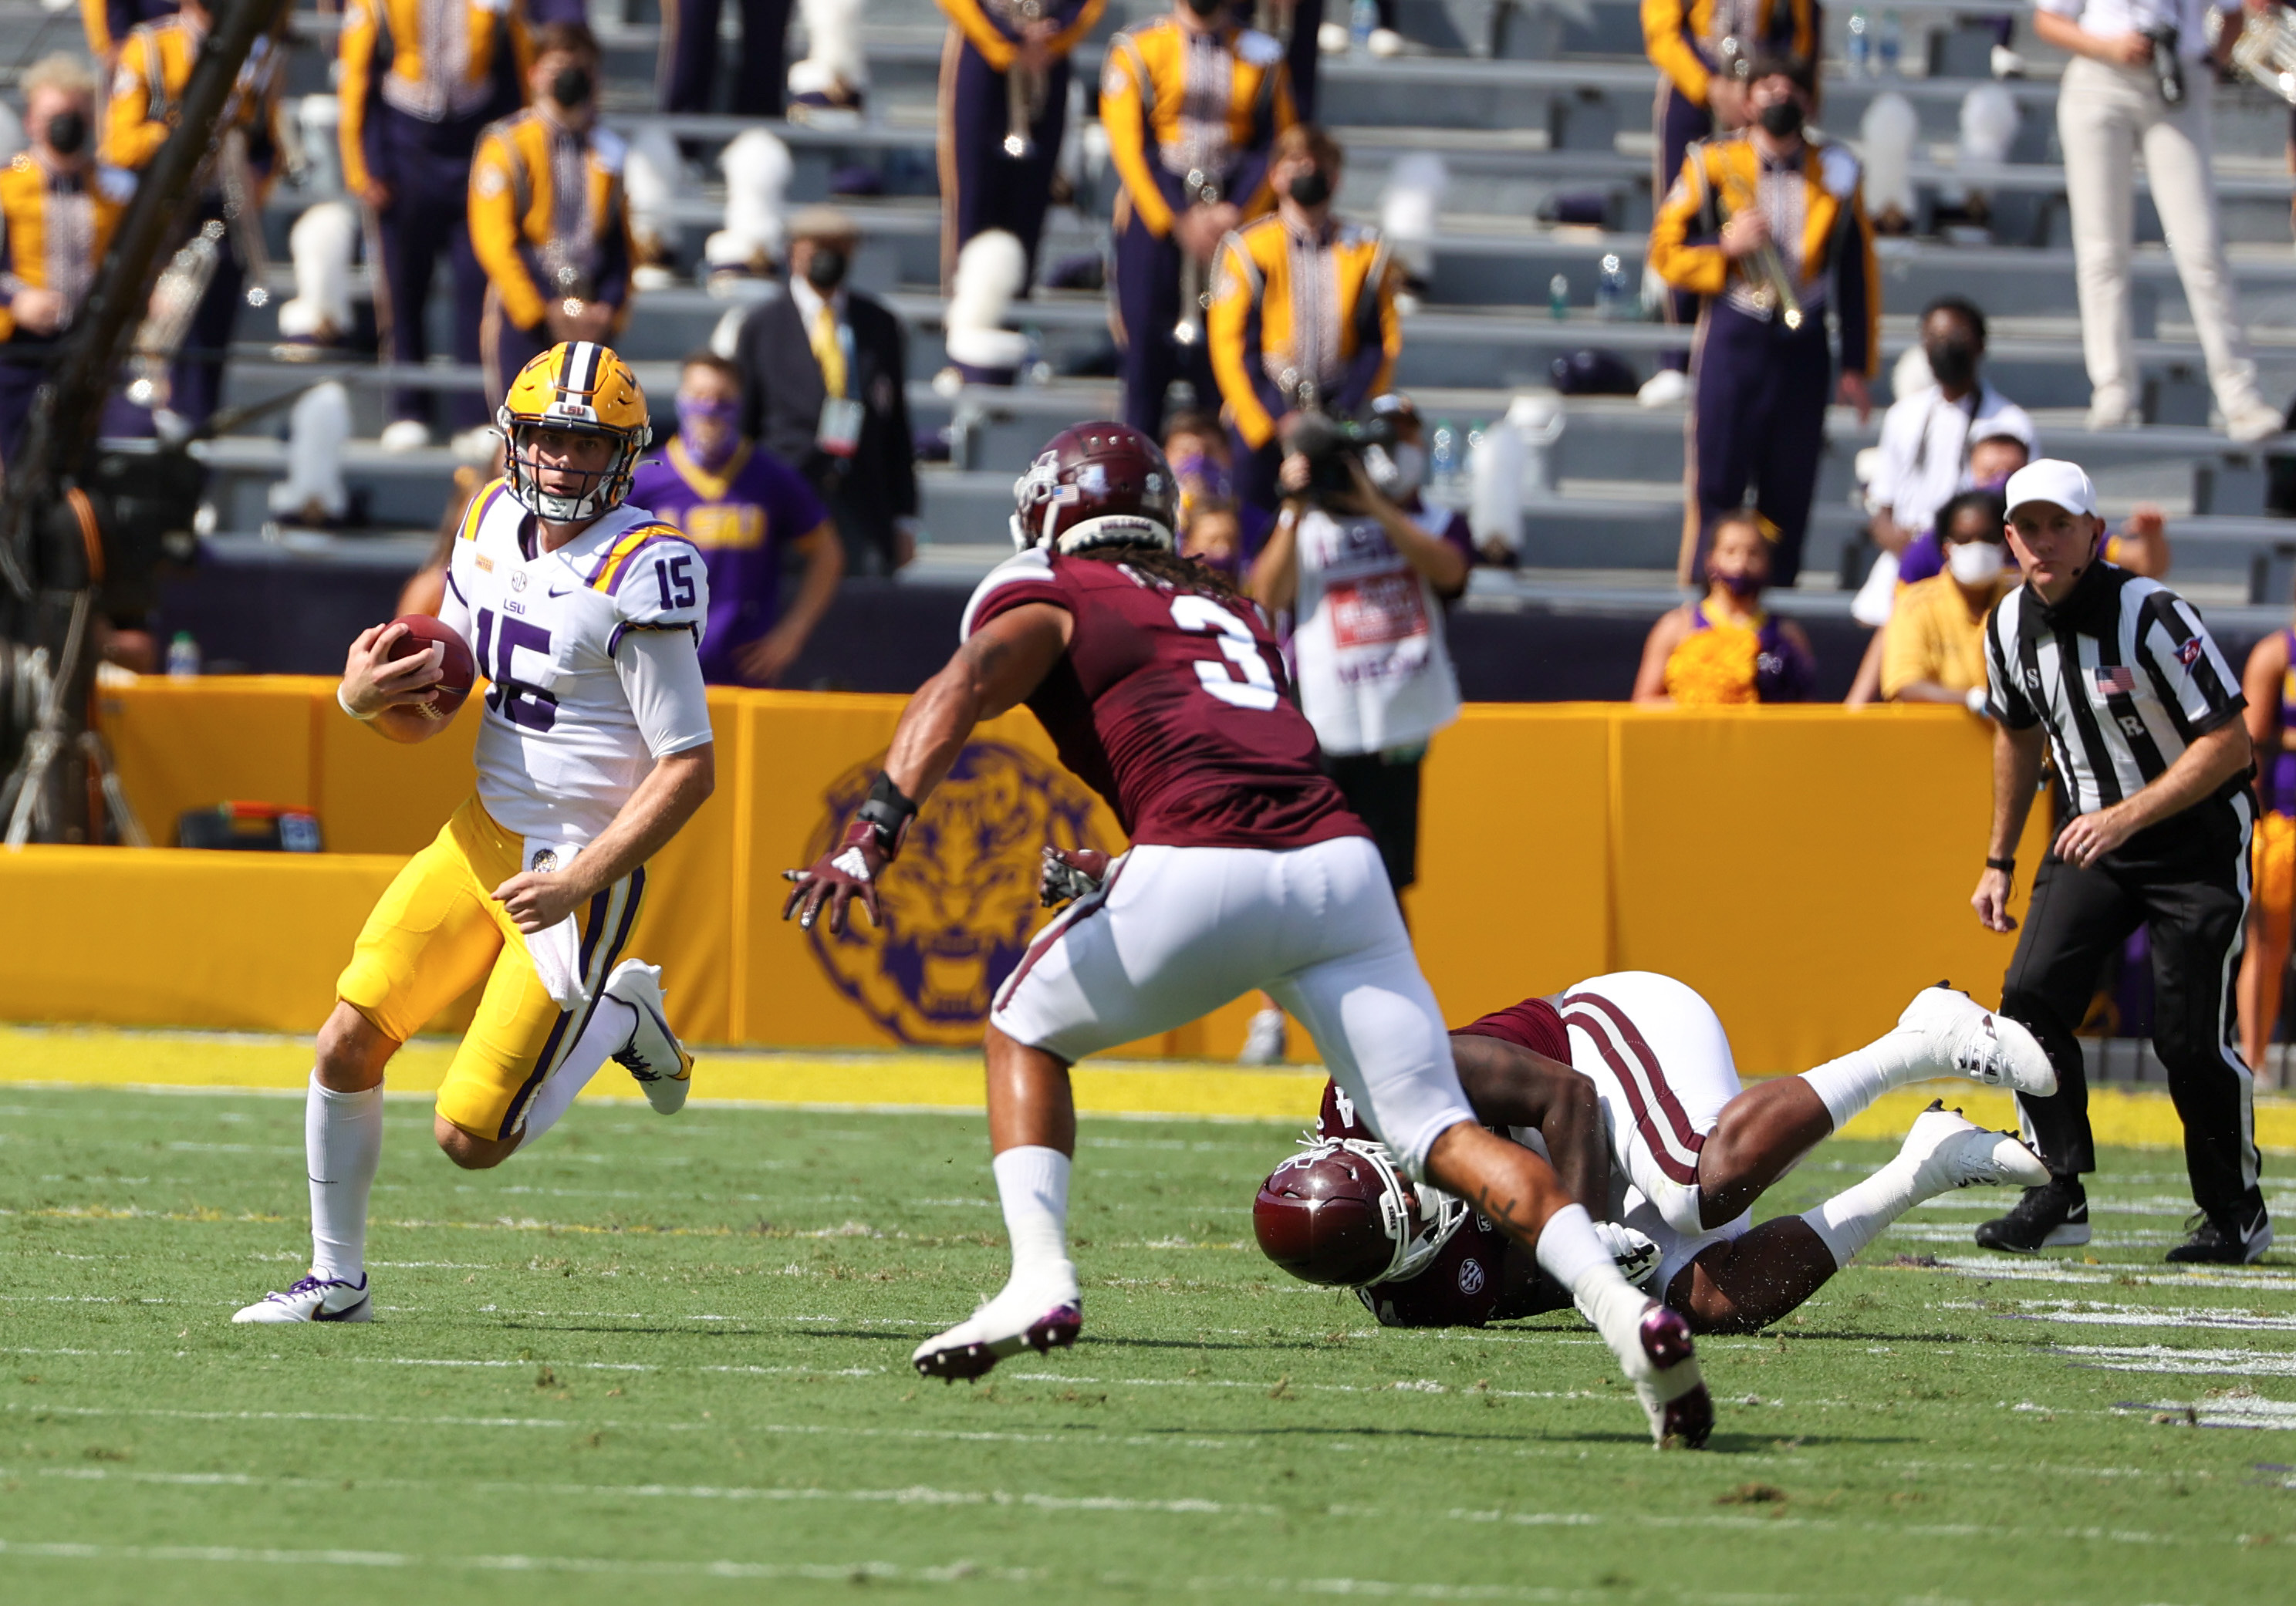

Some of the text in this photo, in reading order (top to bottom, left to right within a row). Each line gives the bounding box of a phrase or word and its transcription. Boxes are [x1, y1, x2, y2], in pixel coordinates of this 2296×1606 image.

[654, 555, 696, 610] 15
[503, 597, 526, 615] LSU
[1170, 594, 1278, 711] 3
[2026, 667, 2040, 689] S
[2116, 715, 2145, 737] R
